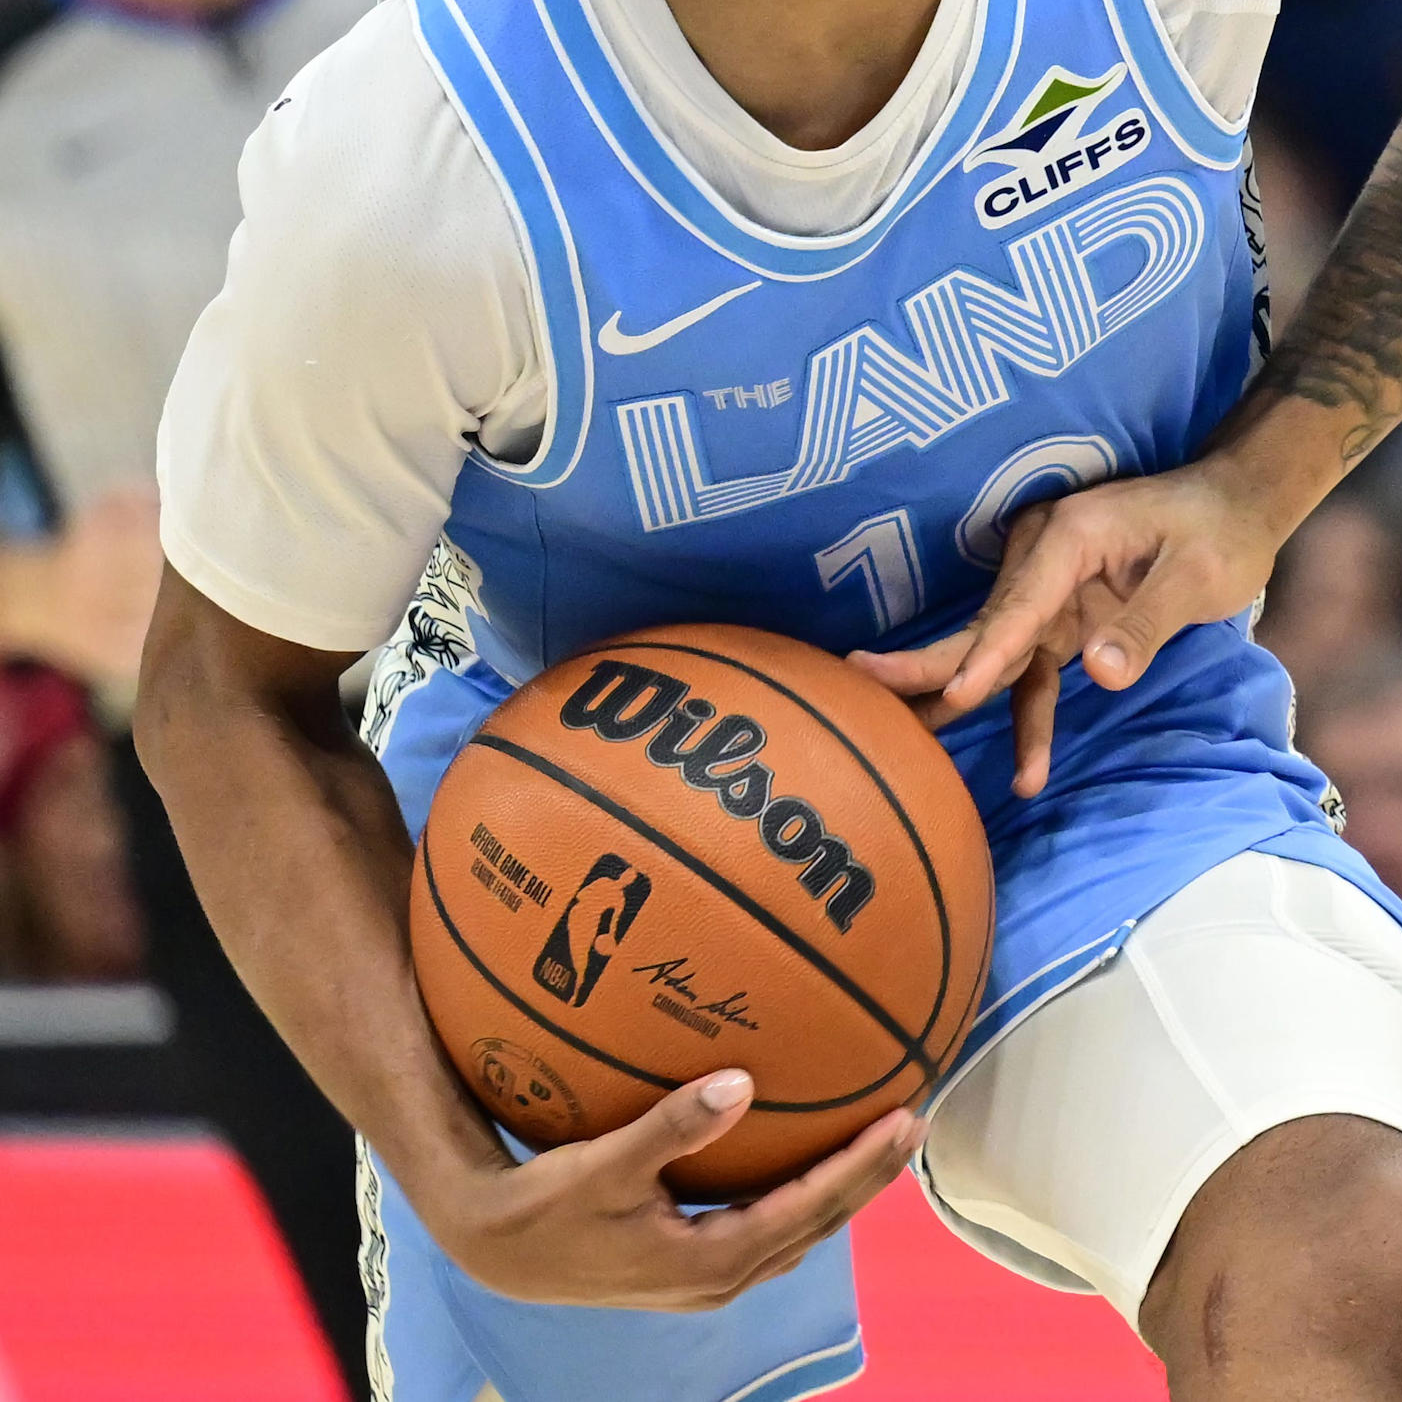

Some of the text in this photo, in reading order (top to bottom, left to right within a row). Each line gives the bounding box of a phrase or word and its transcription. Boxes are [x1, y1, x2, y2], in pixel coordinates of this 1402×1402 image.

[982, 117, 1146, 218] CLIFFS
[616, 177, 1205, 533] LAND
[702, 377, 793, 412] THE
[560, 659, 876, 935] Wilson
[470, 821, 553, 908] OFFICIAL GAME BALL
[539, 957, 572, 990] NBA
